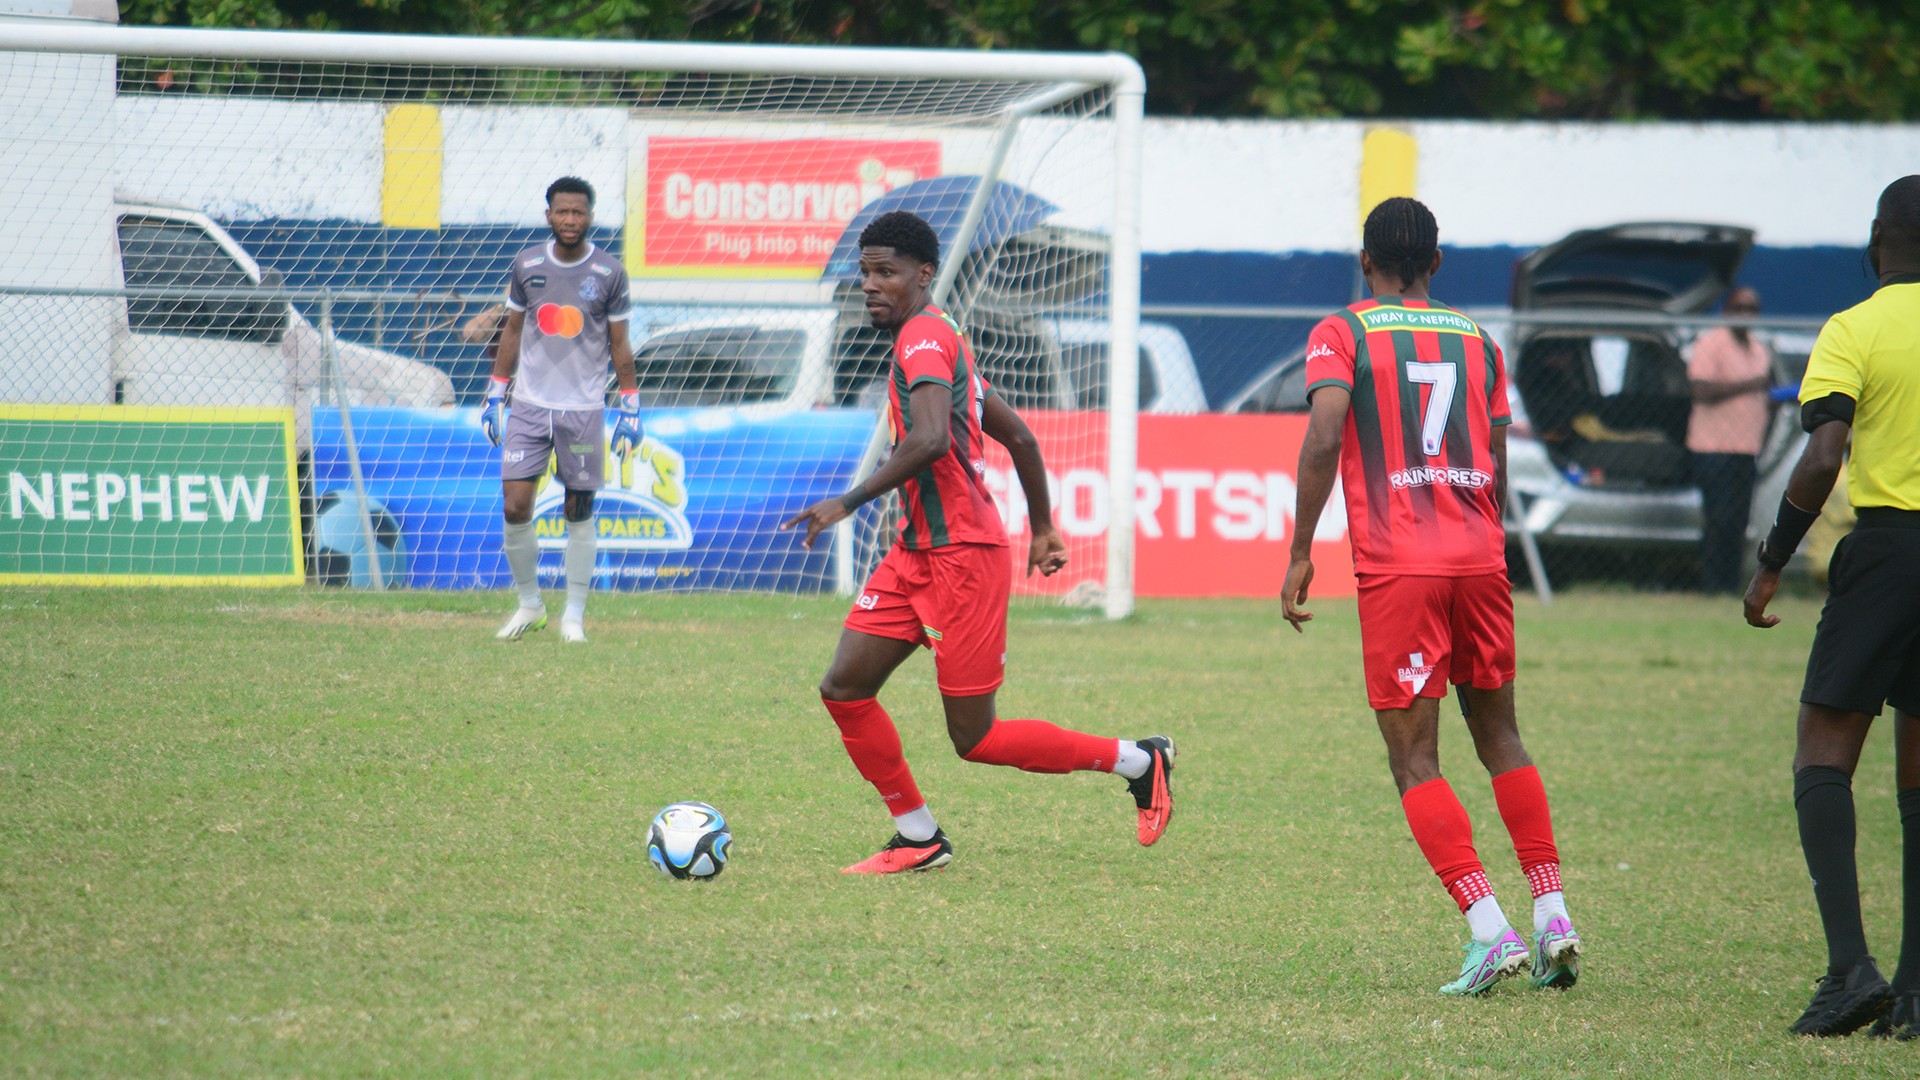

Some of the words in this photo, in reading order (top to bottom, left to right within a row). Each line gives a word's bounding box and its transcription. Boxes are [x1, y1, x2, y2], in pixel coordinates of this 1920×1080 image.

[706, 233, 751, 259] Plug
[757, 233, 797, 253] Into
[803, 235, 835, 254] the
[1368, 312, 1403, 324] WRAY
[1407, 314, 1417, 323] &
[1420, 315, 1471, 330] NEPHEW
[1406, 361, 1457, 456] 7
[1390, 467, 1491, 490] RAINFOREST
[9, 472, 270, 522] NEPHEW
[599, 518, 667, 537] PARTS
[1398, 664, 1436, 676] BAYWES
